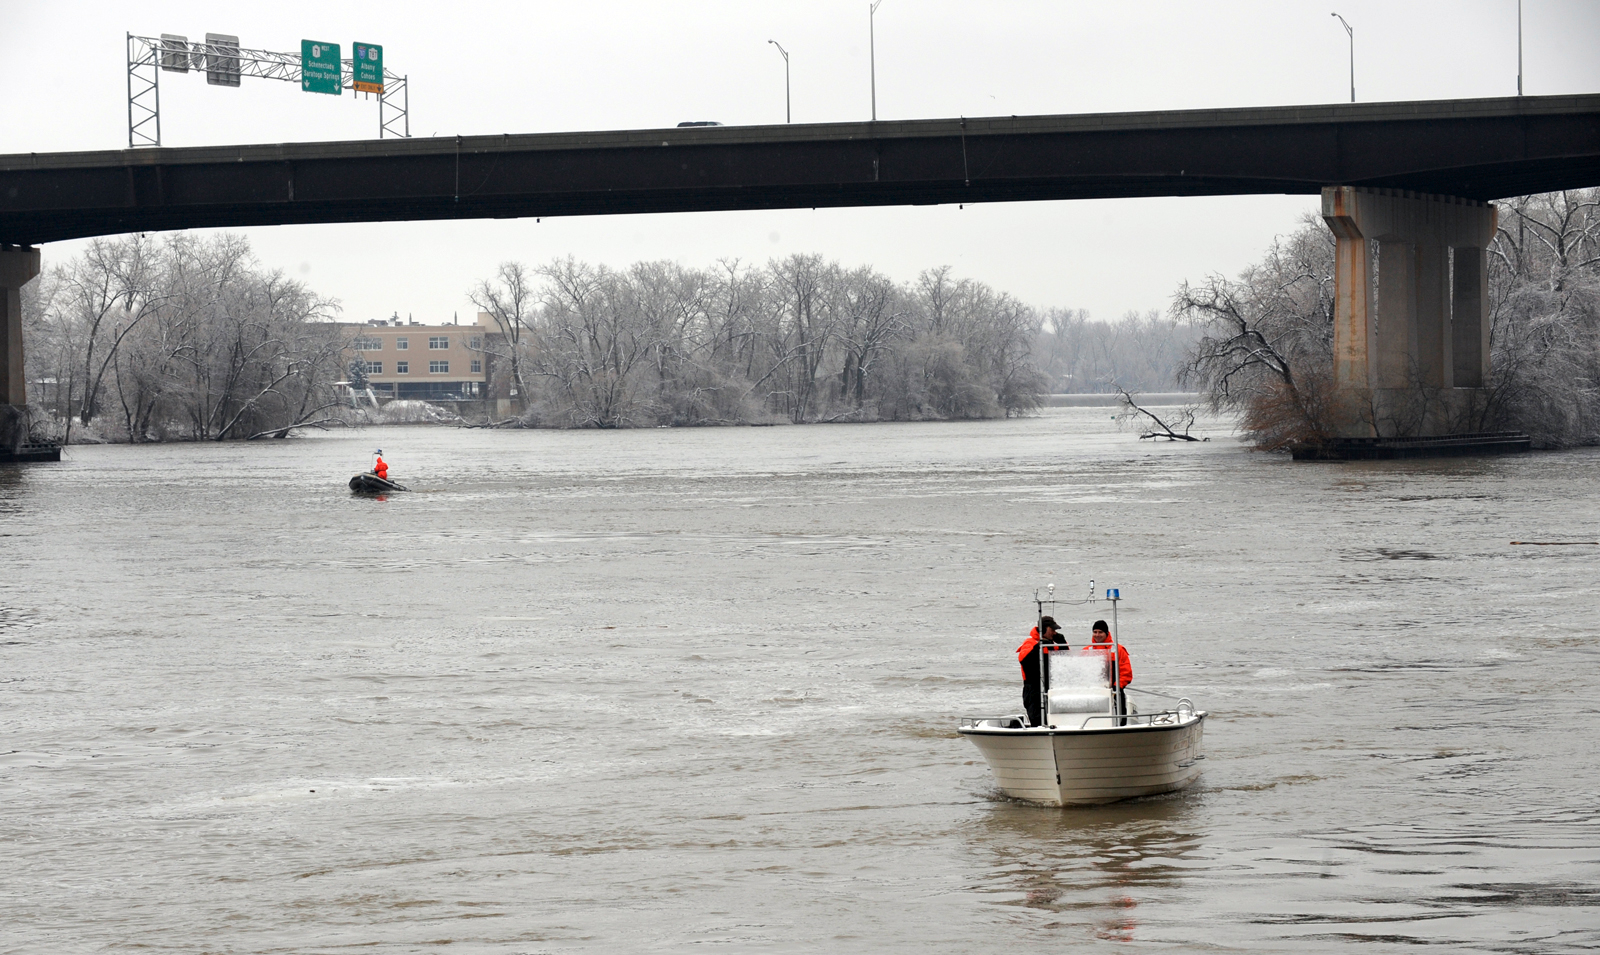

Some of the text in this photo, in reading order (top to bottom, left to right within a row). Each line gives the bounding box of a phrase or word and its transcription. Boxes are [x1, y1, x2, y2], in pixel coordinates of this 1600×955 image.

[308, 61, 335, 71] Schenectady
[361, 63, 376, 72] Albany
[303, 70, 340, 81] Saratoga Springs
